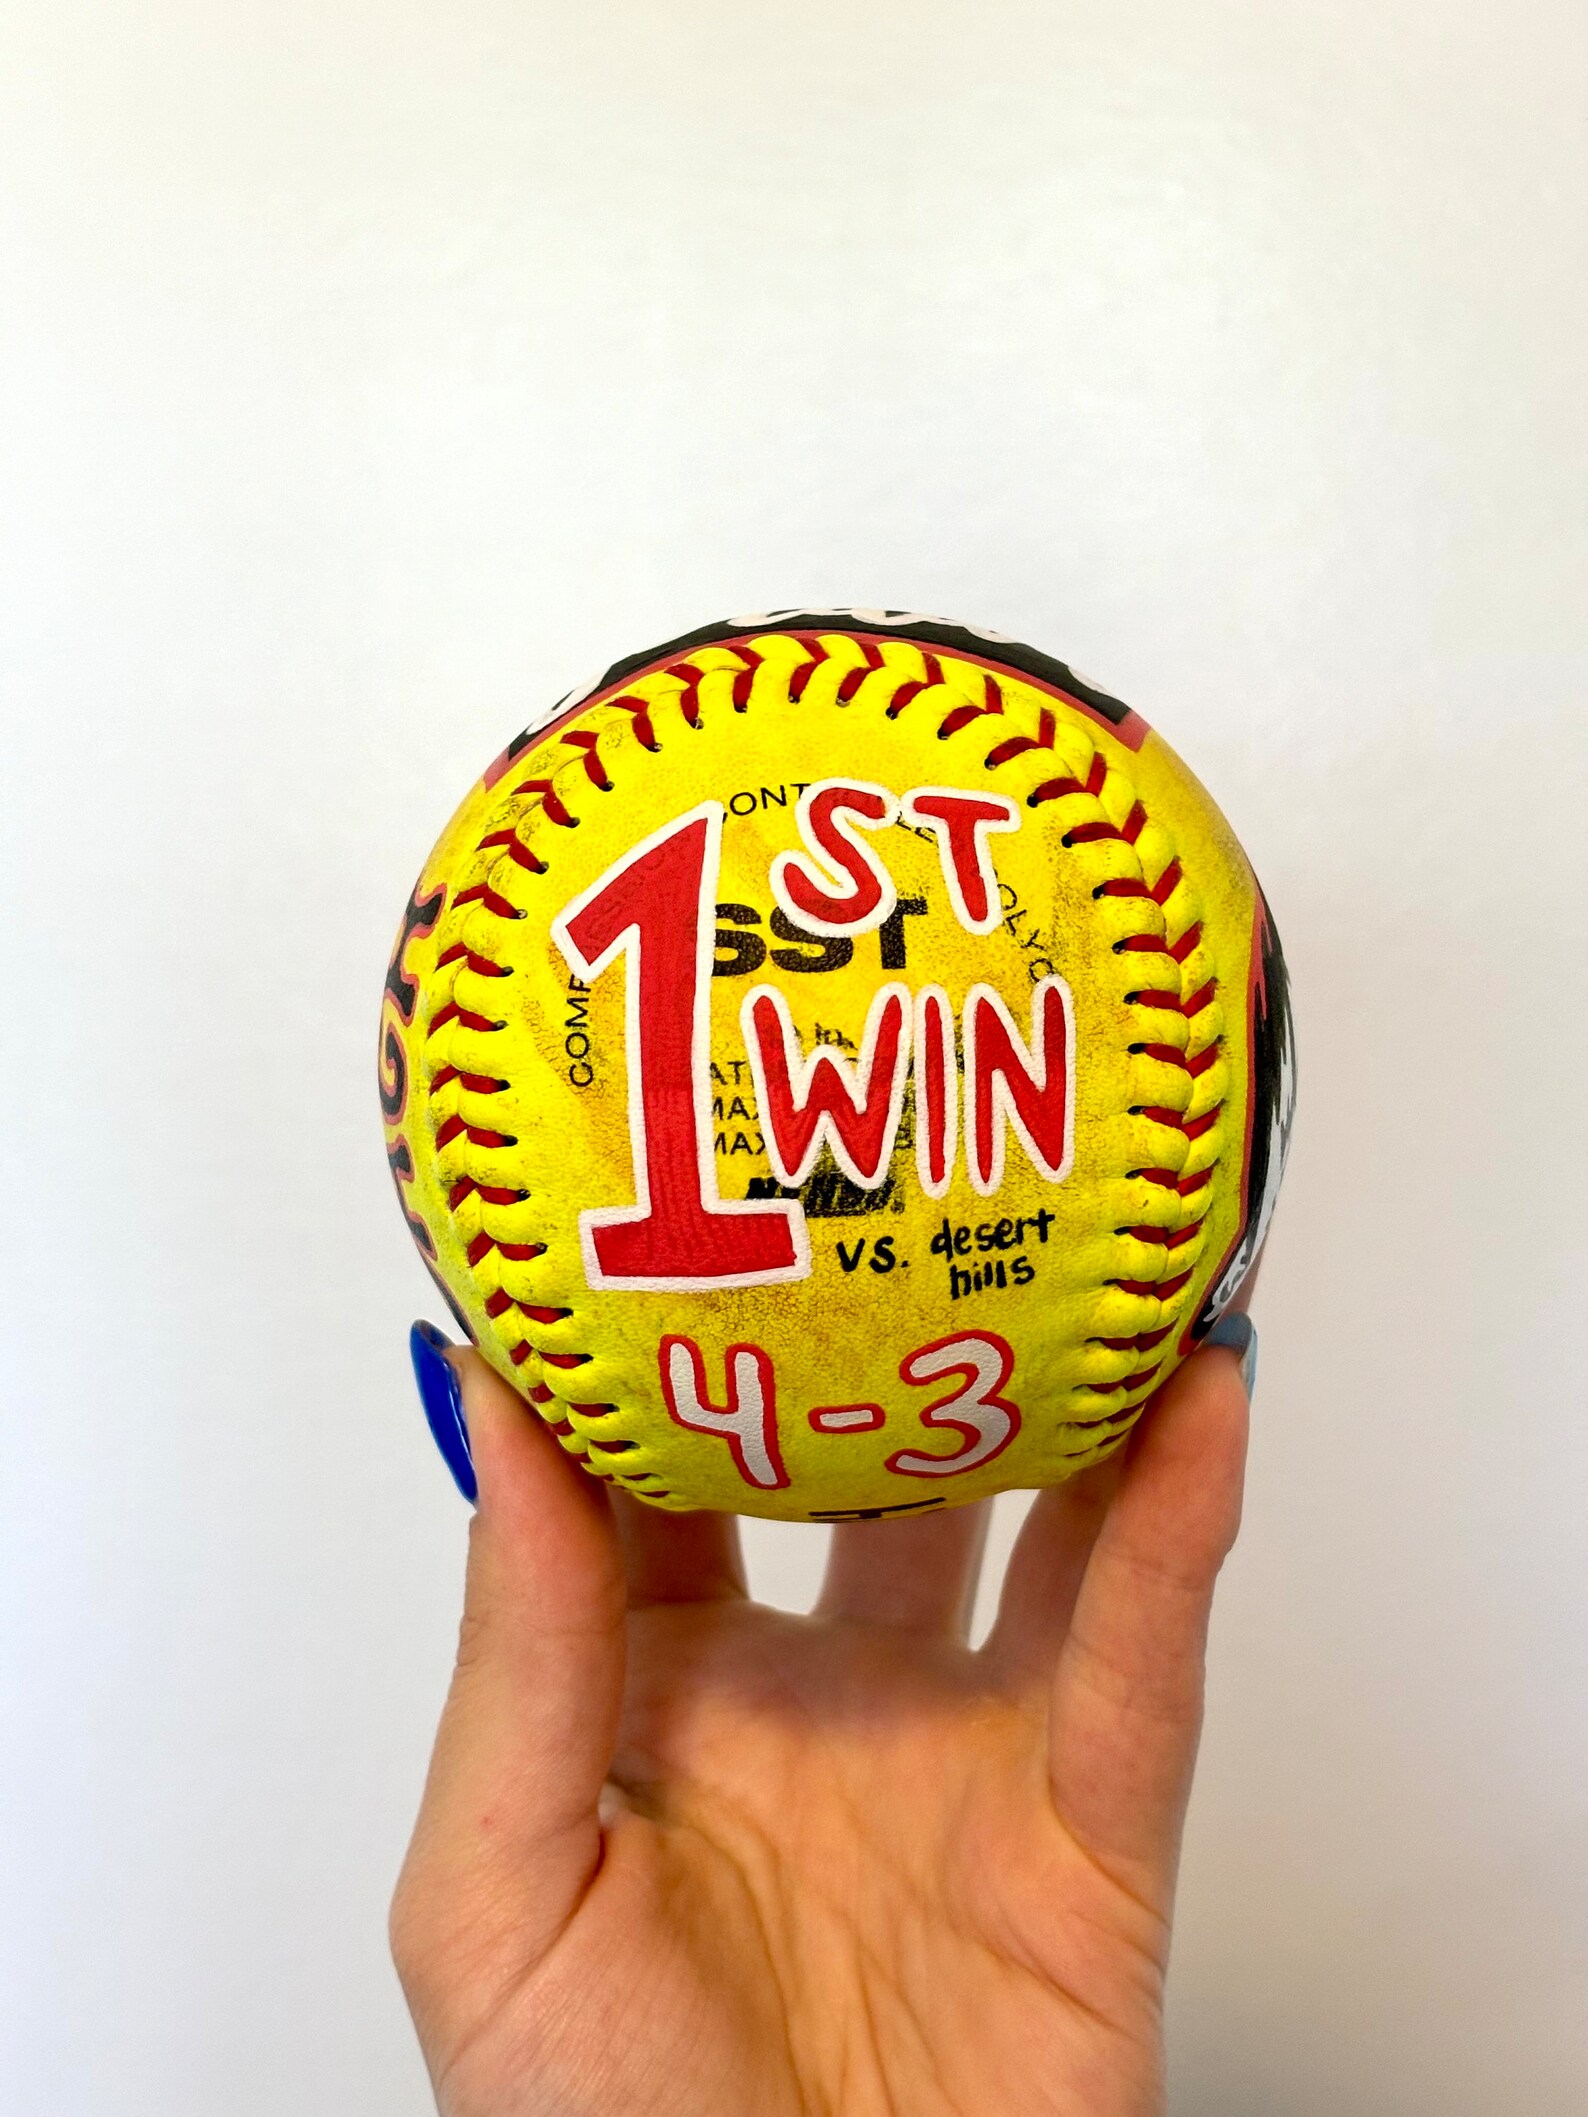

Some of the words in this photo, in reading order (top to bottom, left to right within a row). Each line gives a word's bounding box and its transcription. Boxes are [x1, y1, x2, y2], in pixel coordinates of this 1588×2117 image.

[740, 973, 1076, 1199] WIN
[930, 1207, 1056, 1263] desert
[950, 1255, 1036, 1301] hills
